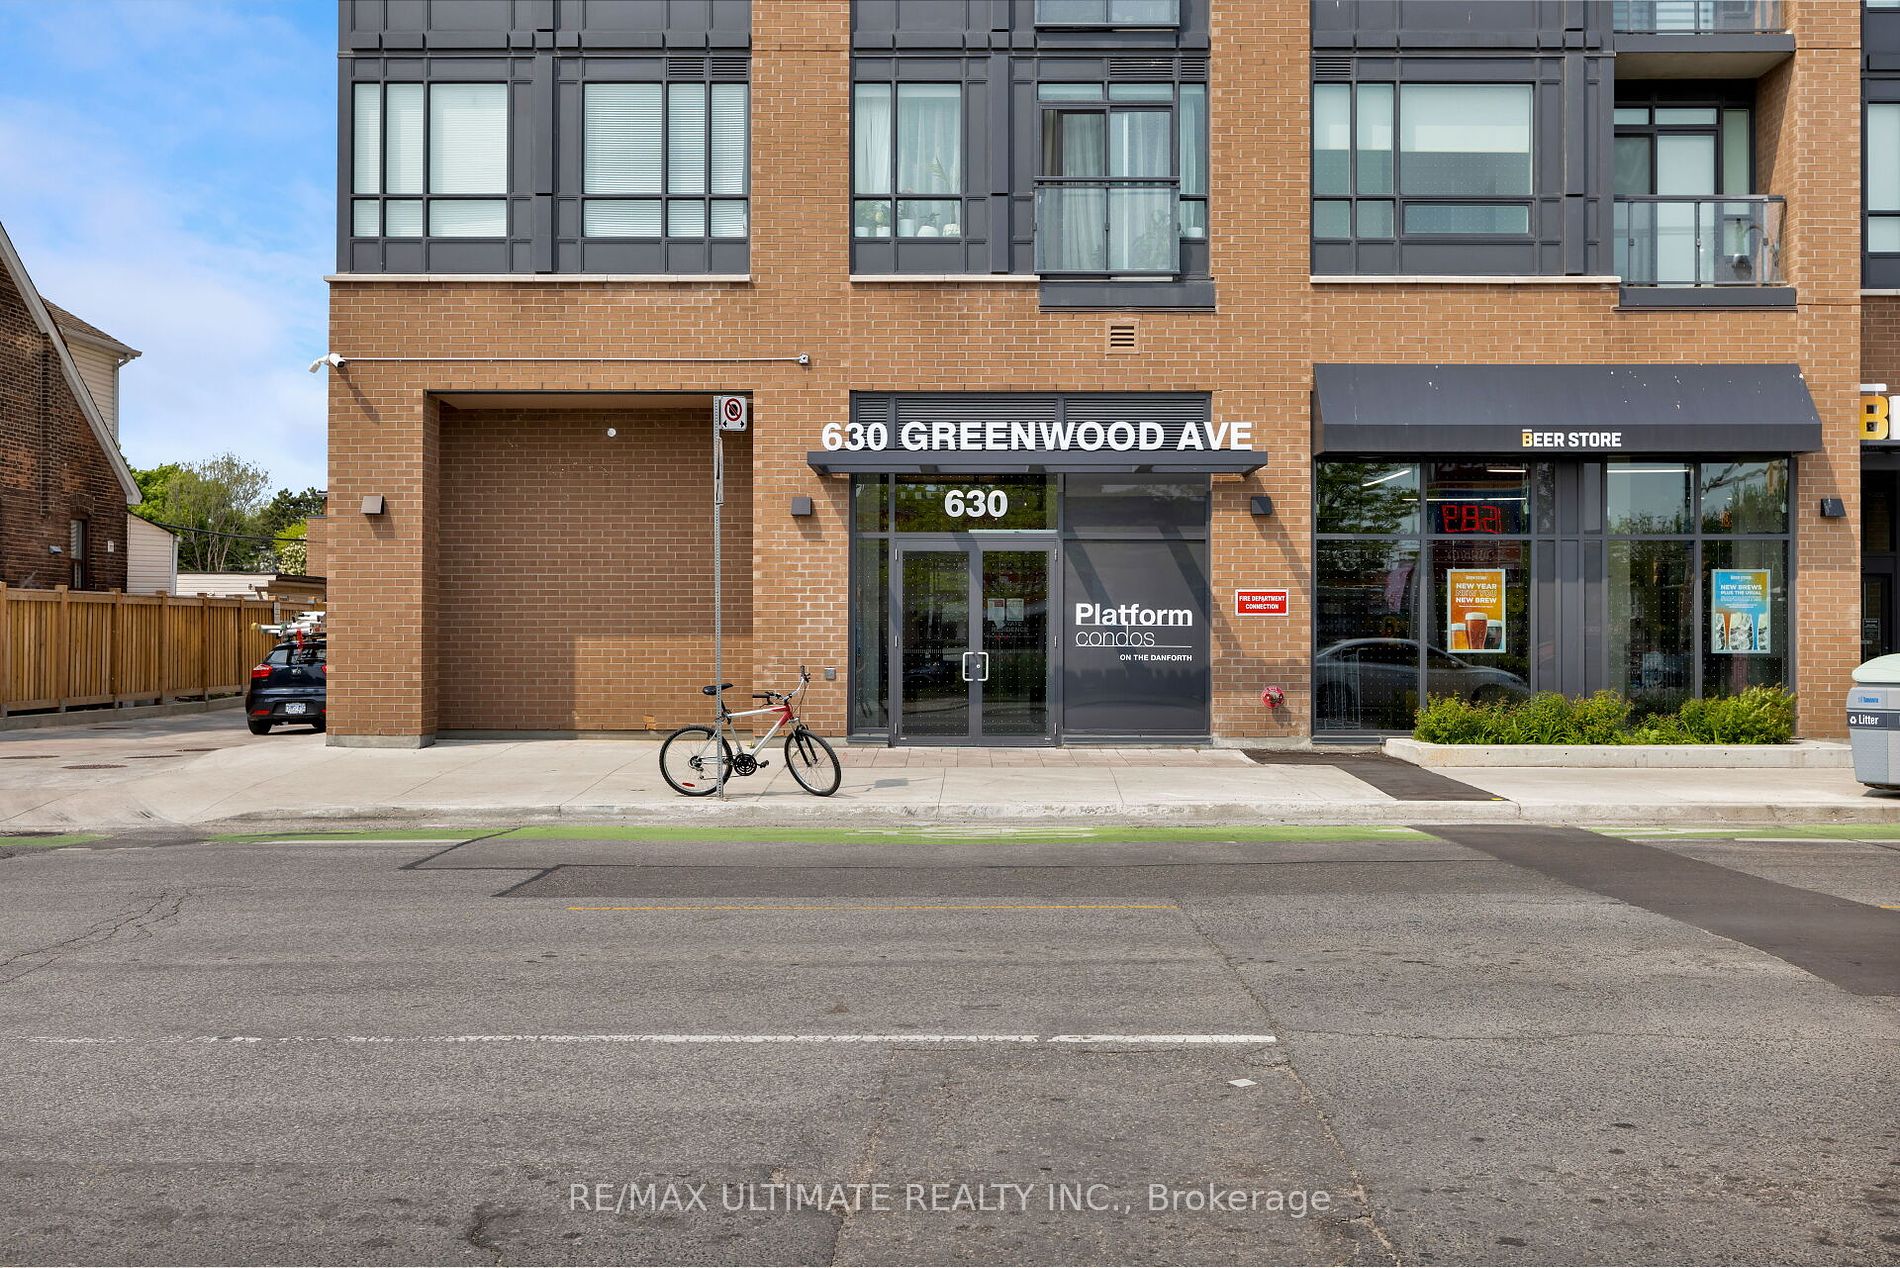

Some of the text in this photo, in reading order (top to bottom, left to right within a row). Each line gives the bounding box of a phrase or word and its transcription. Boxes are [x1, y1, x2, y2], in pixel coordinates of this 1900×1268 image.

[821, 421, 1253, 451] 630 GREENWOOD AVE
[1521, 429, 1622, 448] BEER STORE
[943, 489, 1009, 518] 630
[1075, 603, 1193, 627] Platform
[1075, 627, 1155, 647] condos
[1150, 654, 1193, 662] DANFORTH
[1858, 714, 1879, 725] Litter
